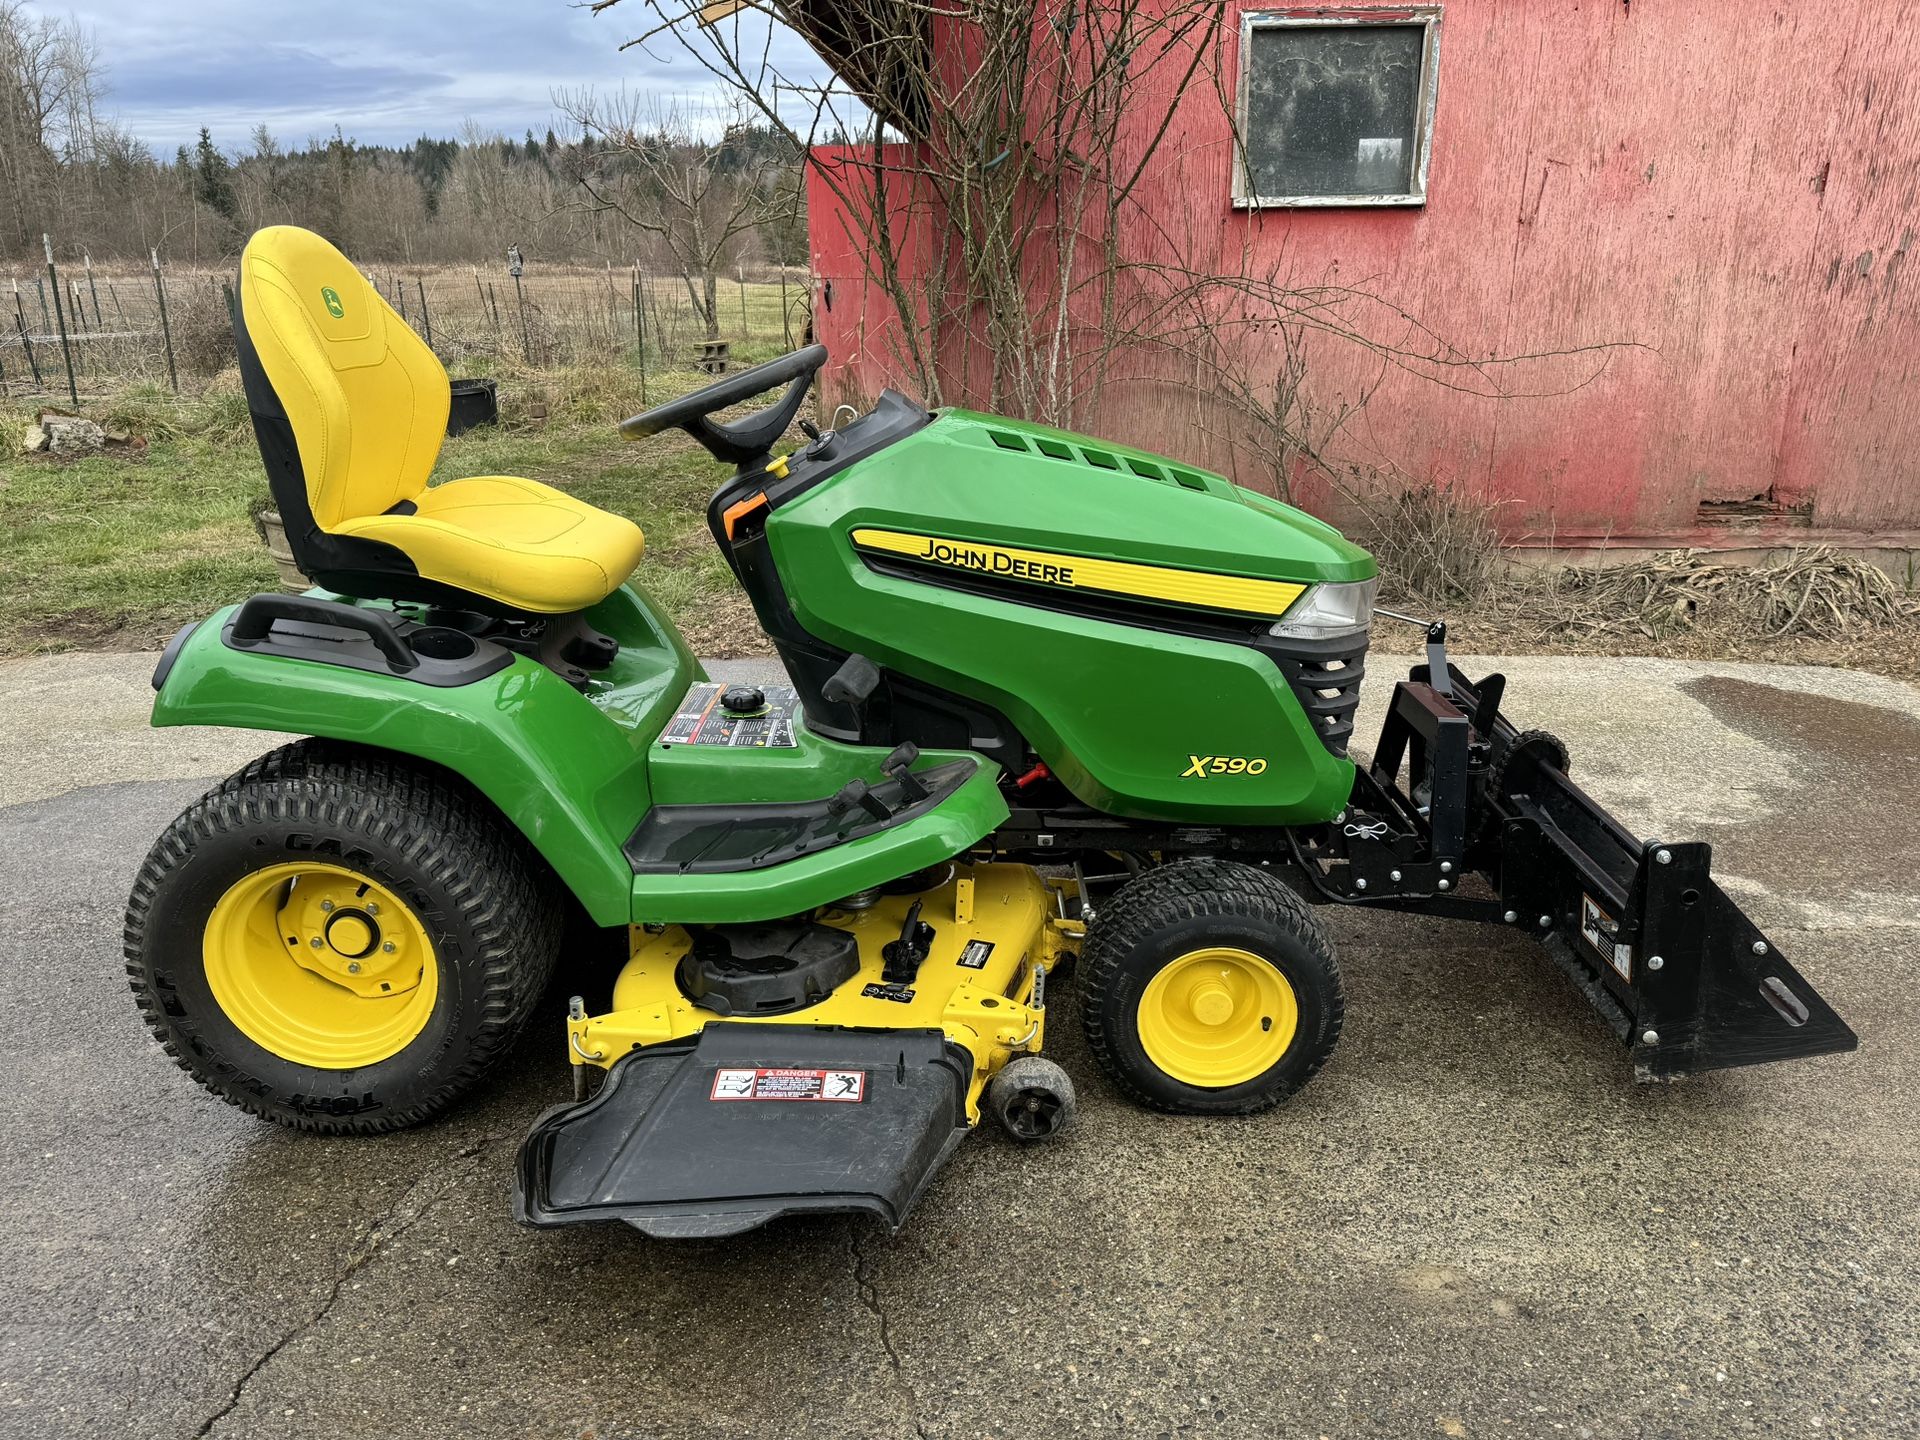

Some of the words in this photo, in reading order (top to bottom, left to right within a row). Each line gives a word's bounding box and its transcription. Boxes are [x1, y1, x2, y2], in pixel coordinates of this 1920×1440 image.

[920, 540, 987, 569] JOHN
[993, 552, 1074, 584] DEERE
[1178, 755, 1268, 779] X590
[284, 833, 463, 956] CARLISLE
[154, 968, 273, 1098] MASTER
